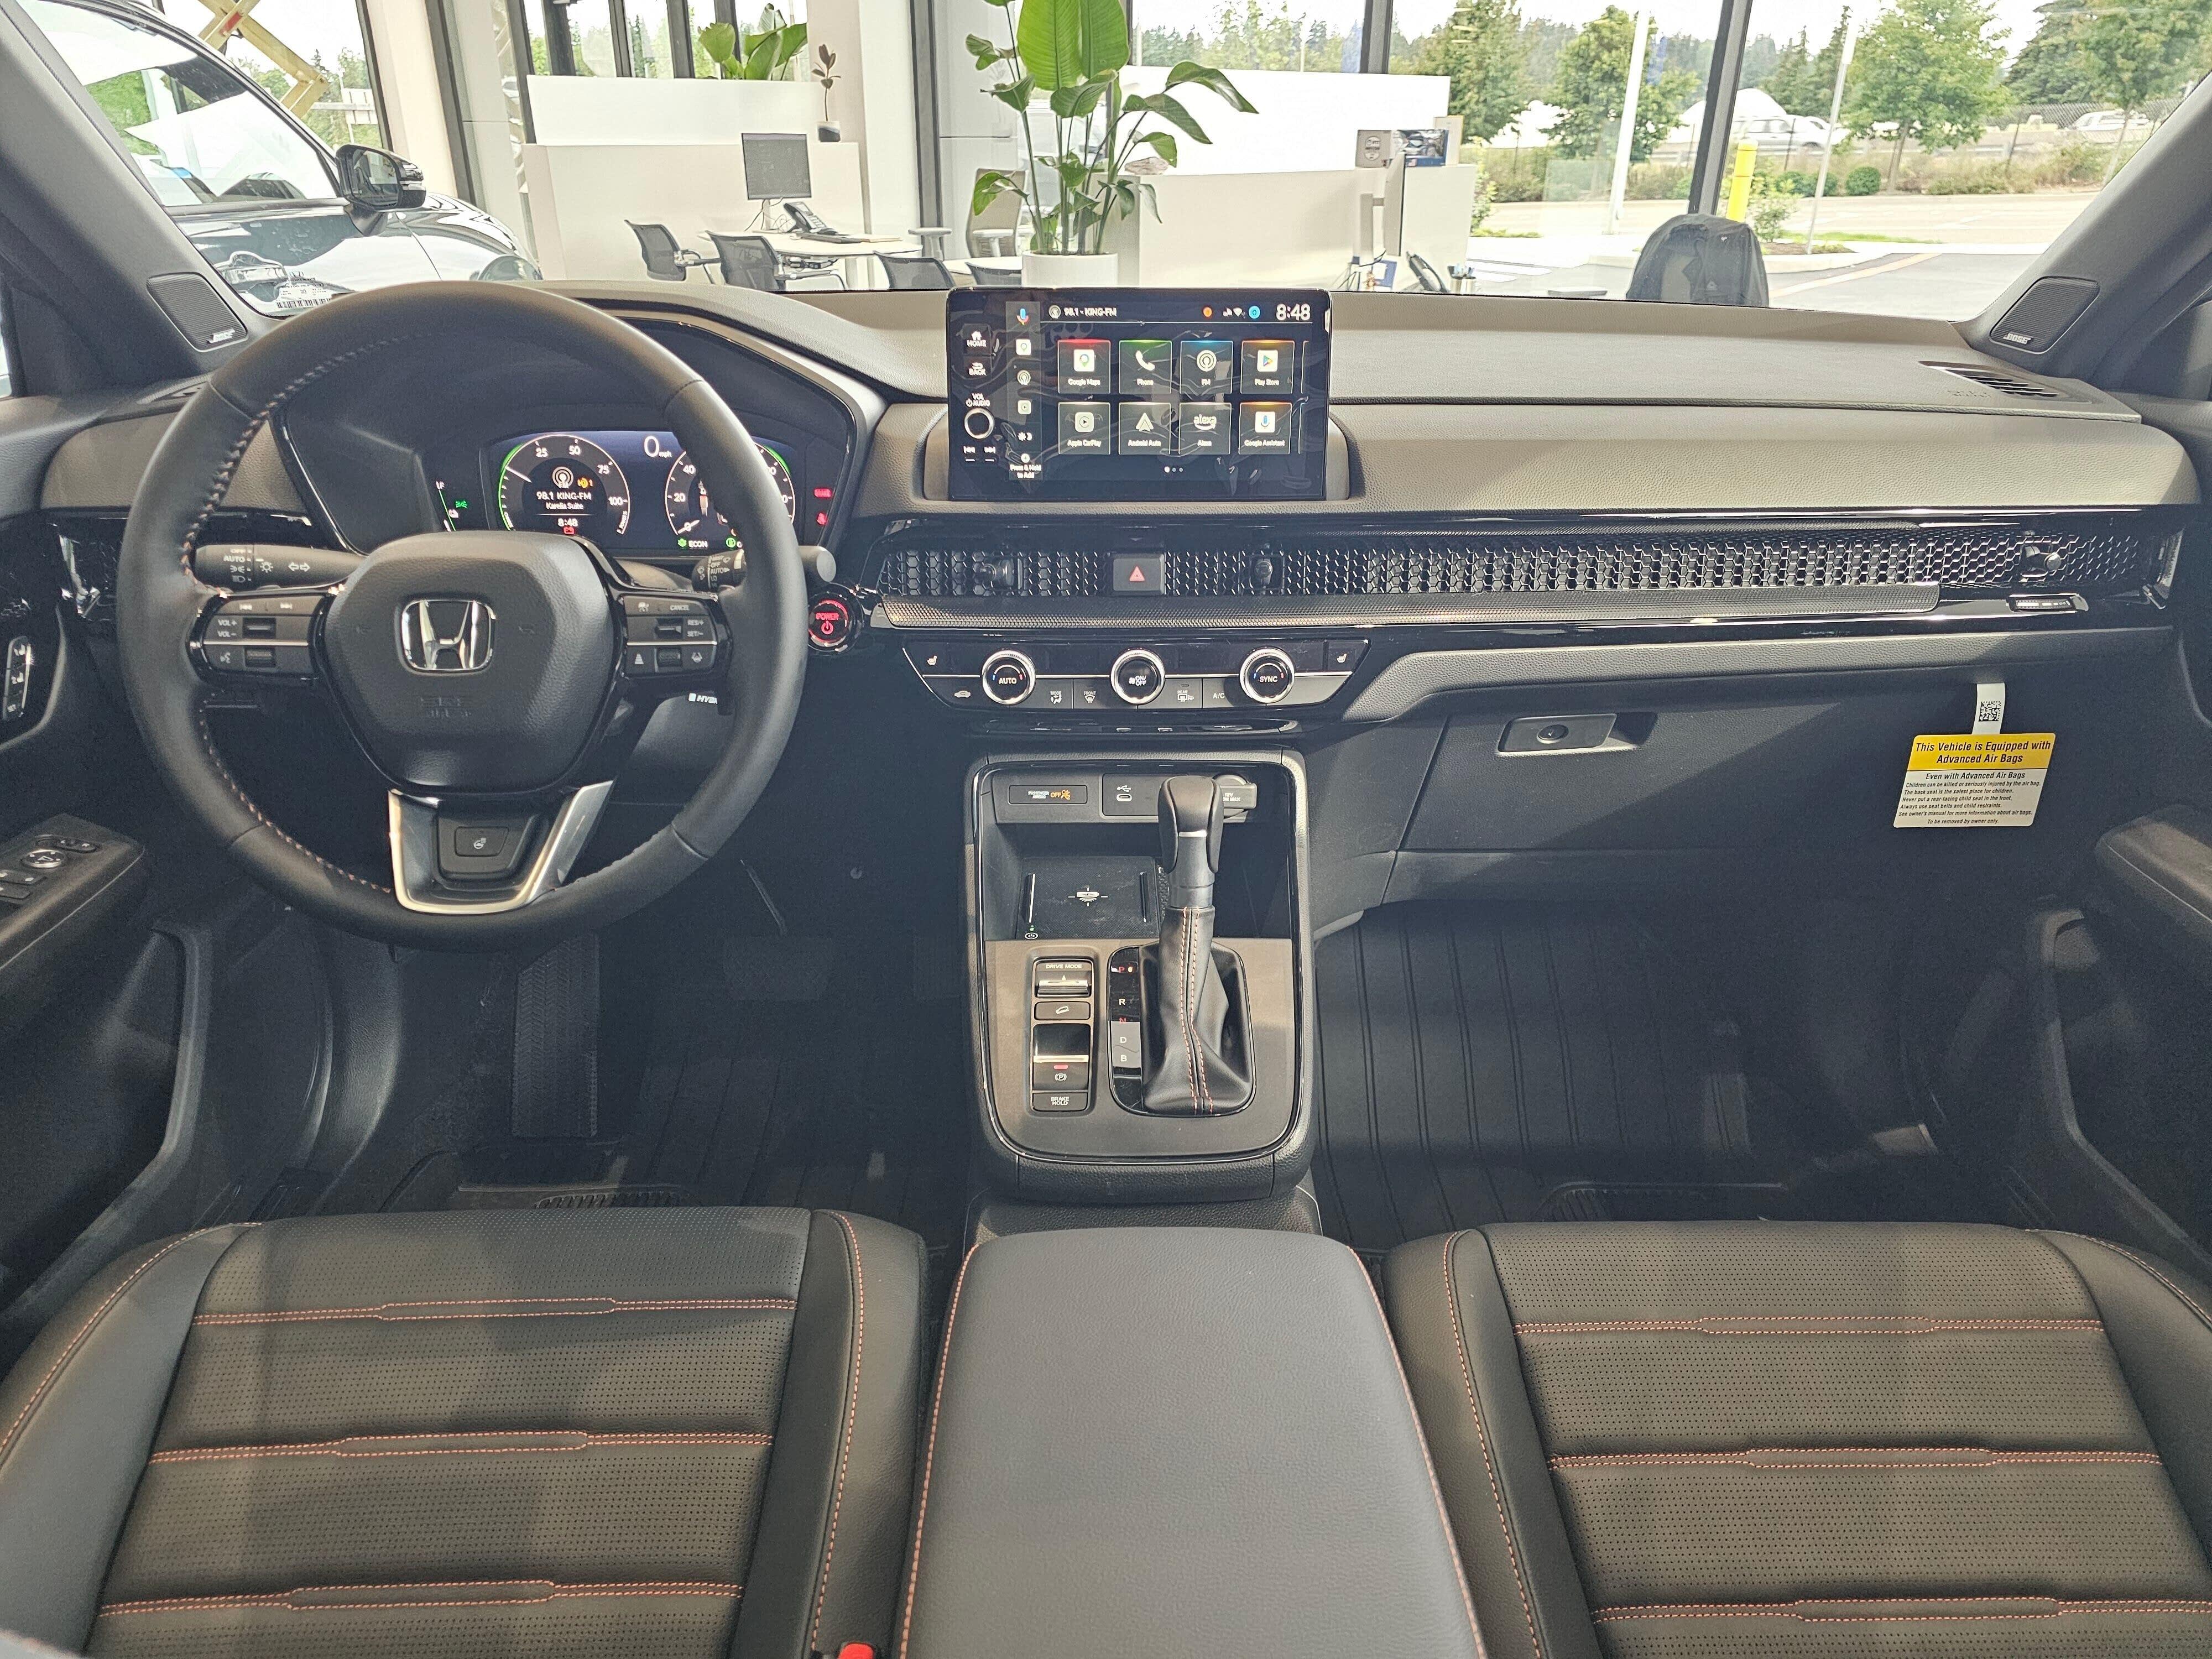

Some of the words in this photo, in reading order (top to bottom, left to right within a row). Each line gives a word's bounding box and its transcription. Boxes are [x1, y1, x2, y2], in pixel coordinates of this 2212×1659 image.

[1276, 304, 1311, 321] 8:48
[2003, 333, 2031, 345] BOSE
[968, 368, 987, 376] BACK
[1193, 414, 1217, 425] alexa
[568, 446, 581, 456] 50
[644, 436, 660, 457] 0
[535, 448, 549, 457] 25
[597, 465, 610, 474] 75
[682, 465, 696, 474] 40
[536, 491, 554, 500] 98.1
[557, 491, 592, 500] KING-FM
[674, 493, 686, 502] 20
[608, 497, 623, 506] 100
[557, 518, 579, 527] 8:48
[223, 555, 245, 563] AUTO
[1916, 743, 1935, 752] This
[1938, 742, 1972, 751] Vehicle
[1974, 742, 1983, 751] is
[1985, 741, 2030, 752] Equipped
[2031, 740, 2051, 750] with
[1936, 754, 1982, 763] Advanced
[1983, 754, 1998, 763] Air
[2000, 754, 2023, 764] Bags
[2008, 771, 2026, 780] Bags
